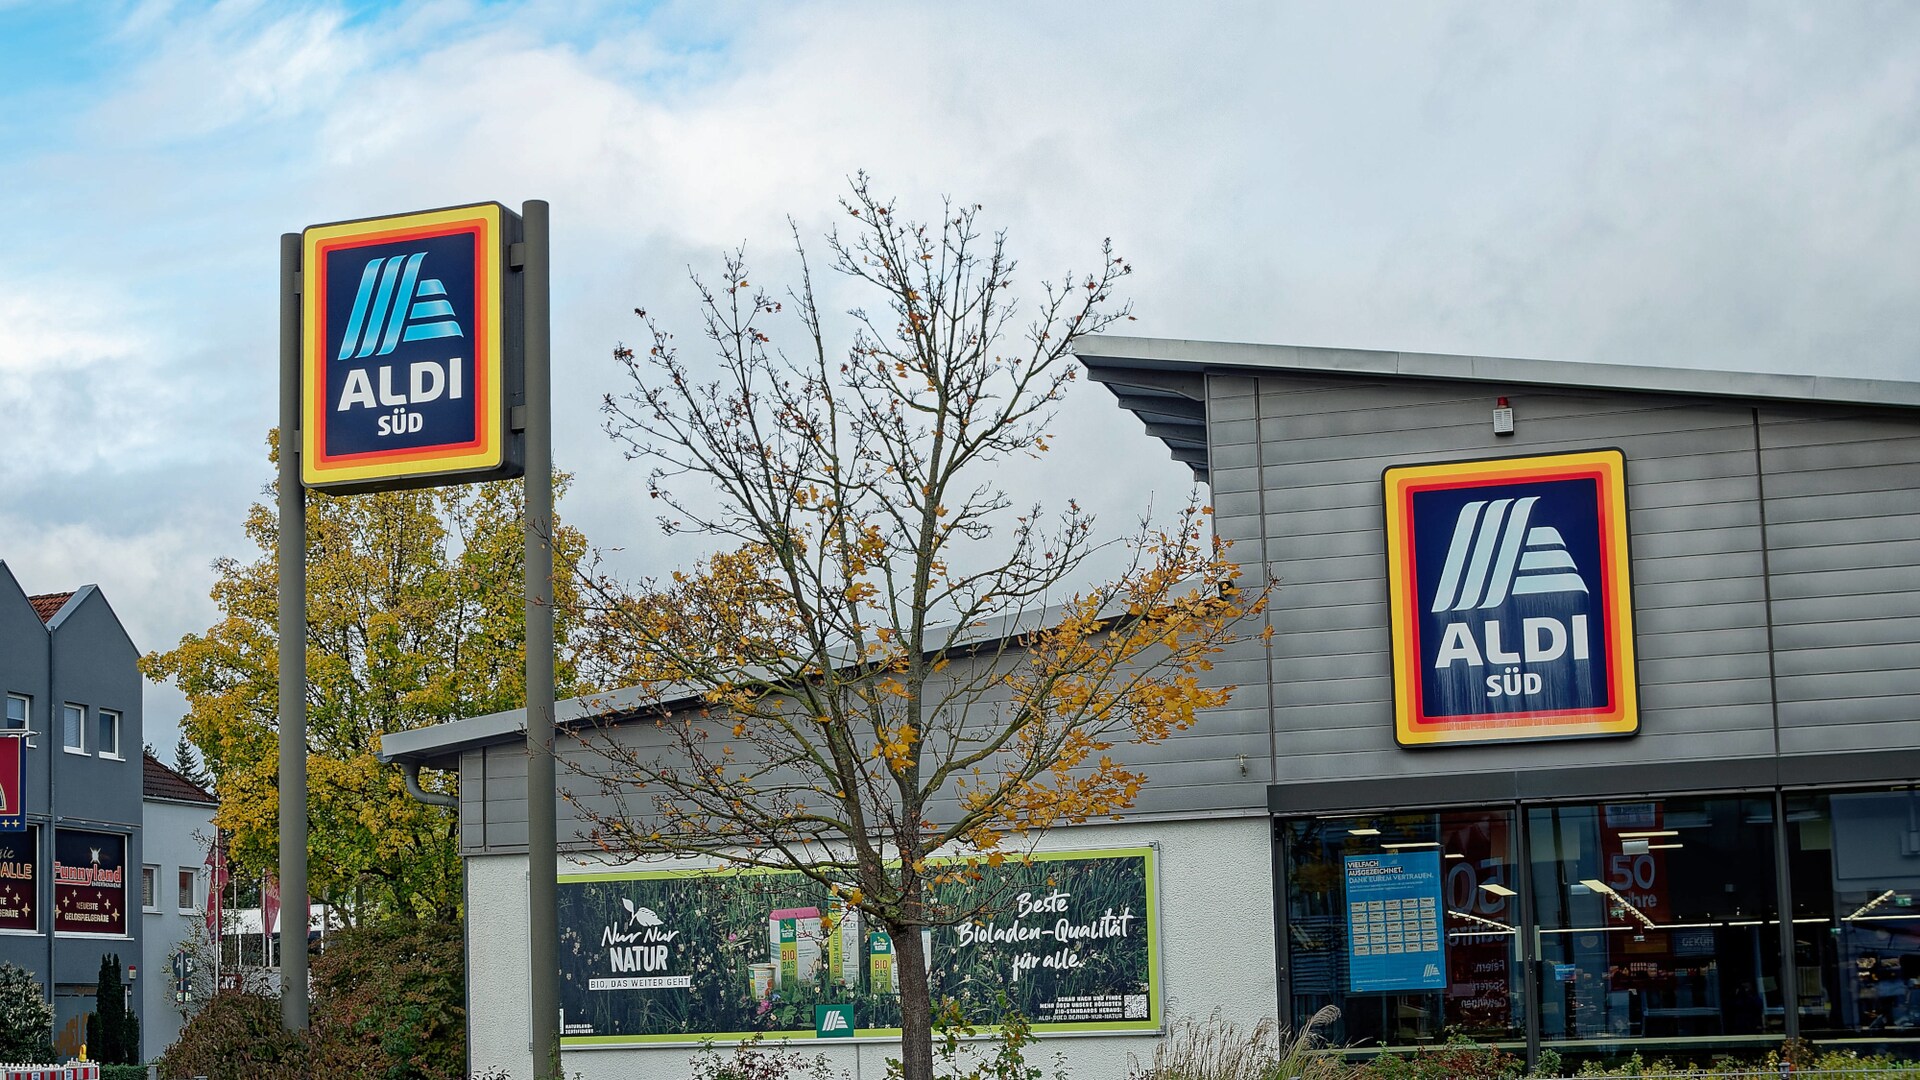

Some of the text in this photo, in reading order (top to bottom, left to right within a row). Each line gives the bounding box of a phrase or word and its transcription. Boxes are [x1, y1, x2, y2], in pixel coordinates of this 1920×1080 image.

[337, 357, 462, 412] ALDI
[377, 407, 424, 436] SÜD
[1434, 614, 1589, 669] ALDI
[1486, 666, 1542, 697] SÜD
[0, 861, 32, 880] ALLE
[53, 861, 122, 886] Funnyland
[1347, 860, 1379, 869] VIELFACH
[1348, 866, 1403, 877] AUSGEZEICHNET.
[1348, 876, 1368, 884] DANK
[1392, 872, 1434, 880] VERTRAUEN.
[1610, 854, 1656, 891] 50
[1016, 888, 1071, 918] Beste
[601, 921, 680, 947] Nur Nur
[958, 907, 1134, 947] Bioladen-Qualität
[609, 945, 669, 973] NATUR
[782, 960, 795, 970] DAS
[1012, 947, 1085, 982] für alle.
[590, 977, 689, 989] BIO, DAS WEITER GEHT
